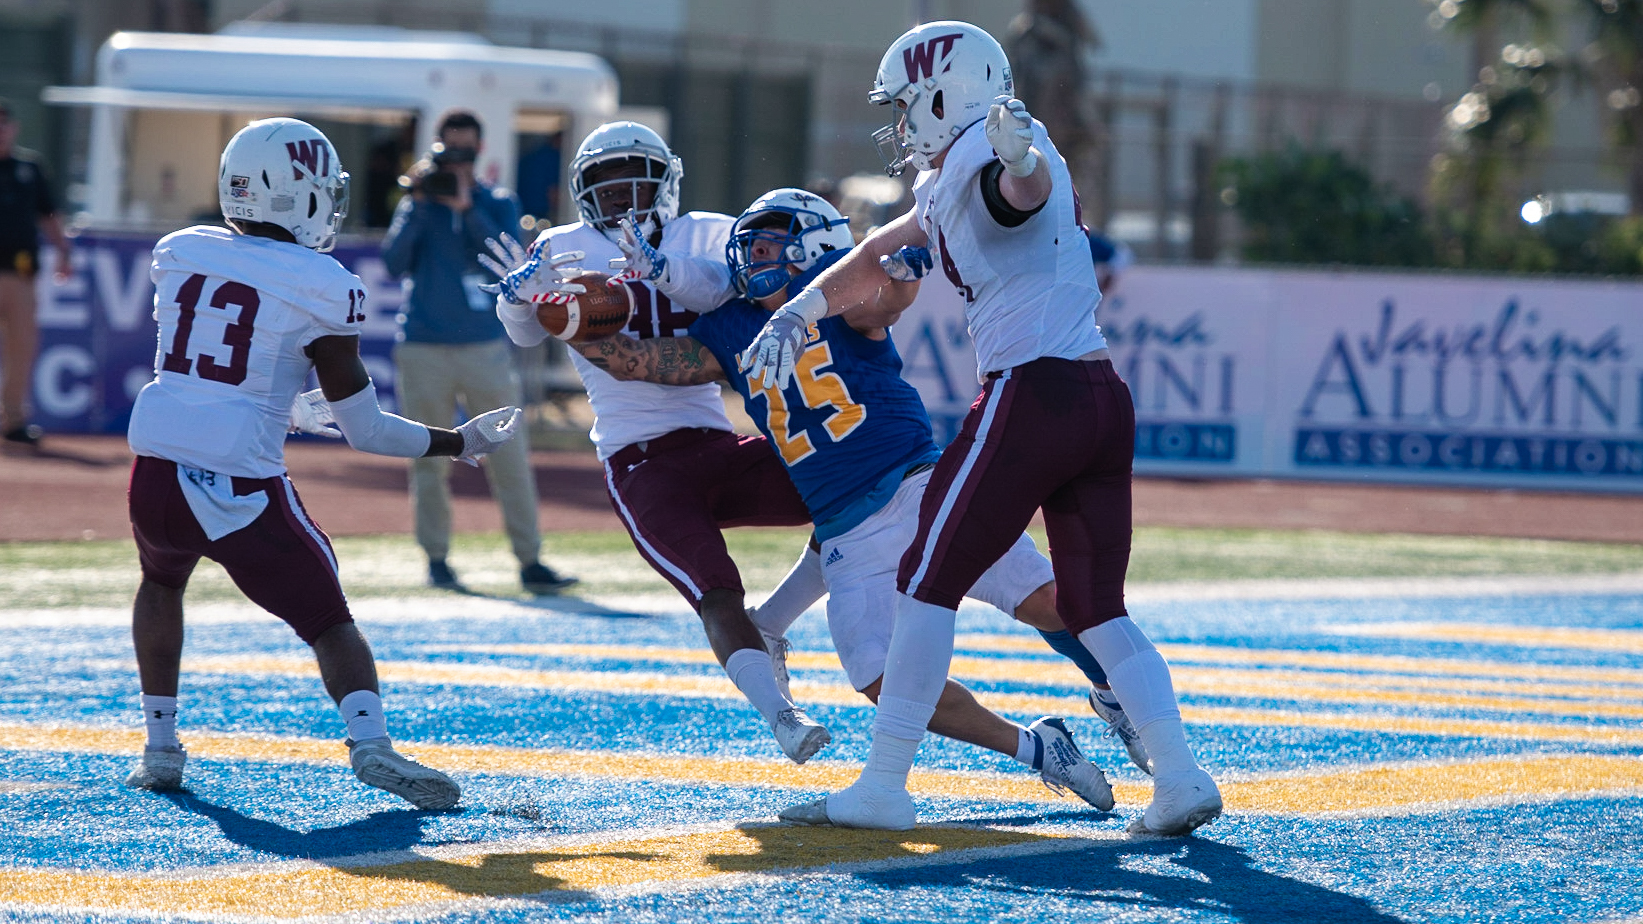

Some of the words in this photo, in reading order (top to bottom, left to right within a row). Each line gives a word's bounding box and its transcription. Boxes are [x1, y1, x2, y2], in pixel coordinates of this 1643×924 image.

[903, 33, 964, 84] WT
[285, 138, 330, 181] WT
[224, 206, 255, 217] VICIS
[162, 273, 261, 386] 13
[1360, 296, 1630, 365] Javelina
[1303, 431, 1643, 476] ASSOCIATION
